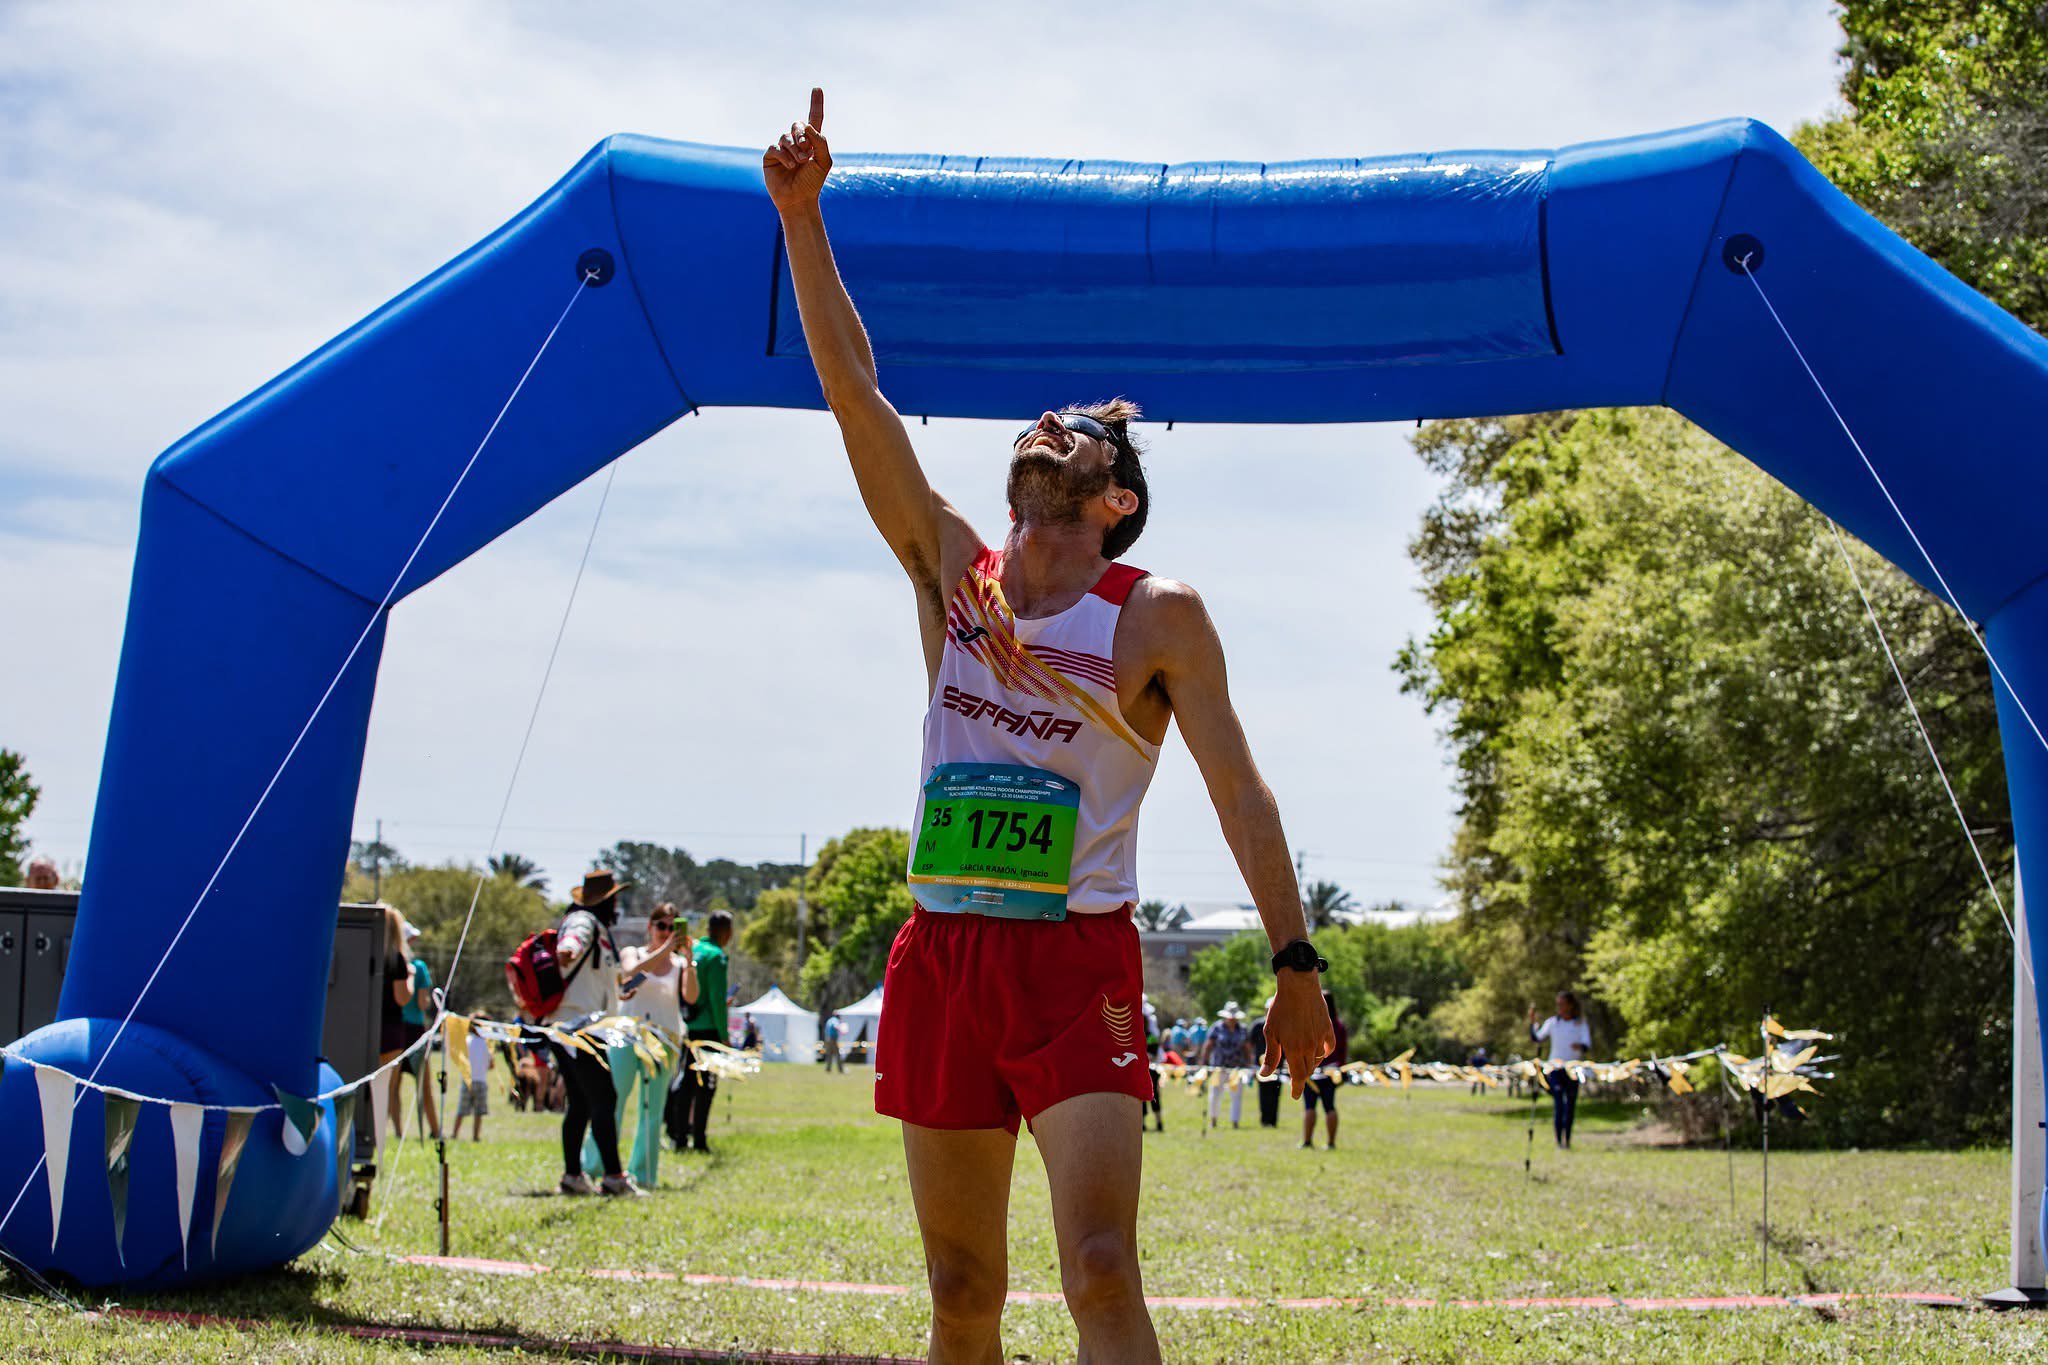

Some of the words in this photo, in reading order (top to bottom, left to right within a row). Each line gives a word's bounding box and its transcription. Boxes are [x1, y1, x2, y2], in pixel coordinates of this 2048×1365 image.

[943, 685, 1082, 743] ESPAÑA
[925, 839, 937, 854] M
[931, 807, 953, 827] 35
[967, 809, 1053, 855] 1754
[1020, 868, 1049, 878] Ignacio
